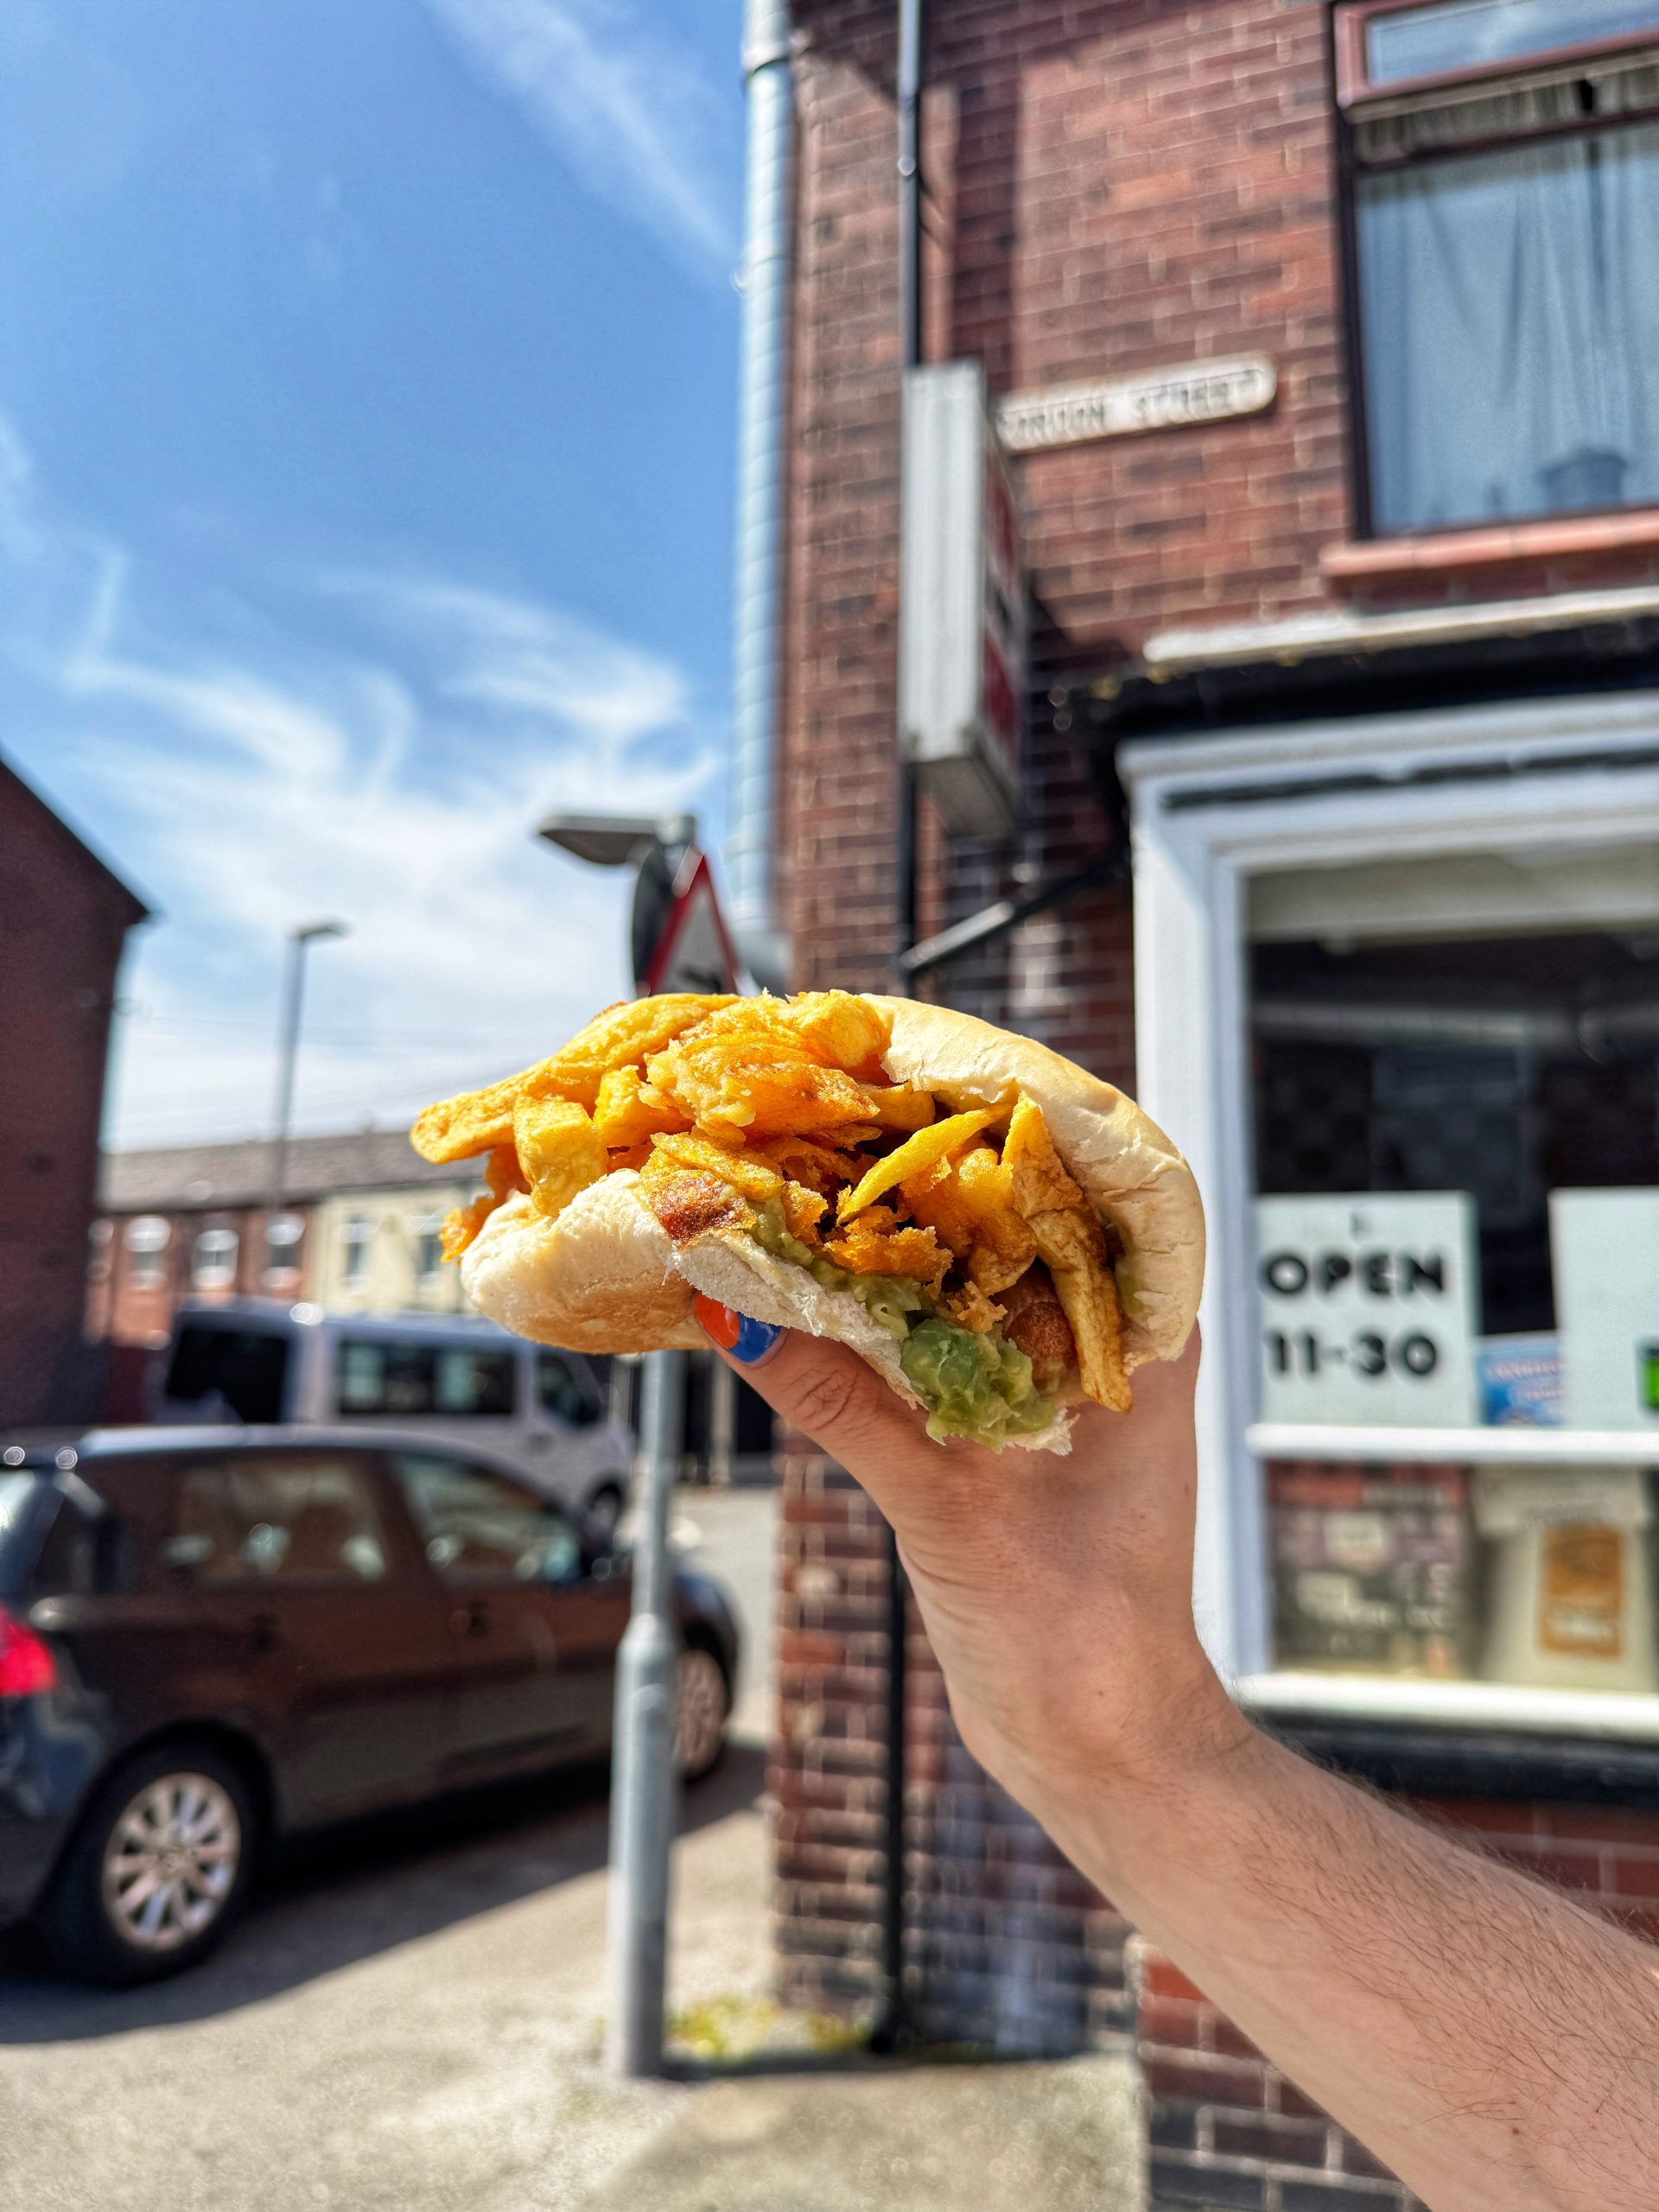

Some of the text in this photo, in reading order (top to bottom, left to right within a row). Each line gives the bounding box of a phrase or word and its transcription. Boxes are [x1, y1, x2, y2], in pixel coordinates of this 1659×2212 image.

[1133, 366, 1260, 416] STREET
[1262, 1251, 1445, 1295] OPEN
[1265, 1331, 1438, 1376] 11-30
